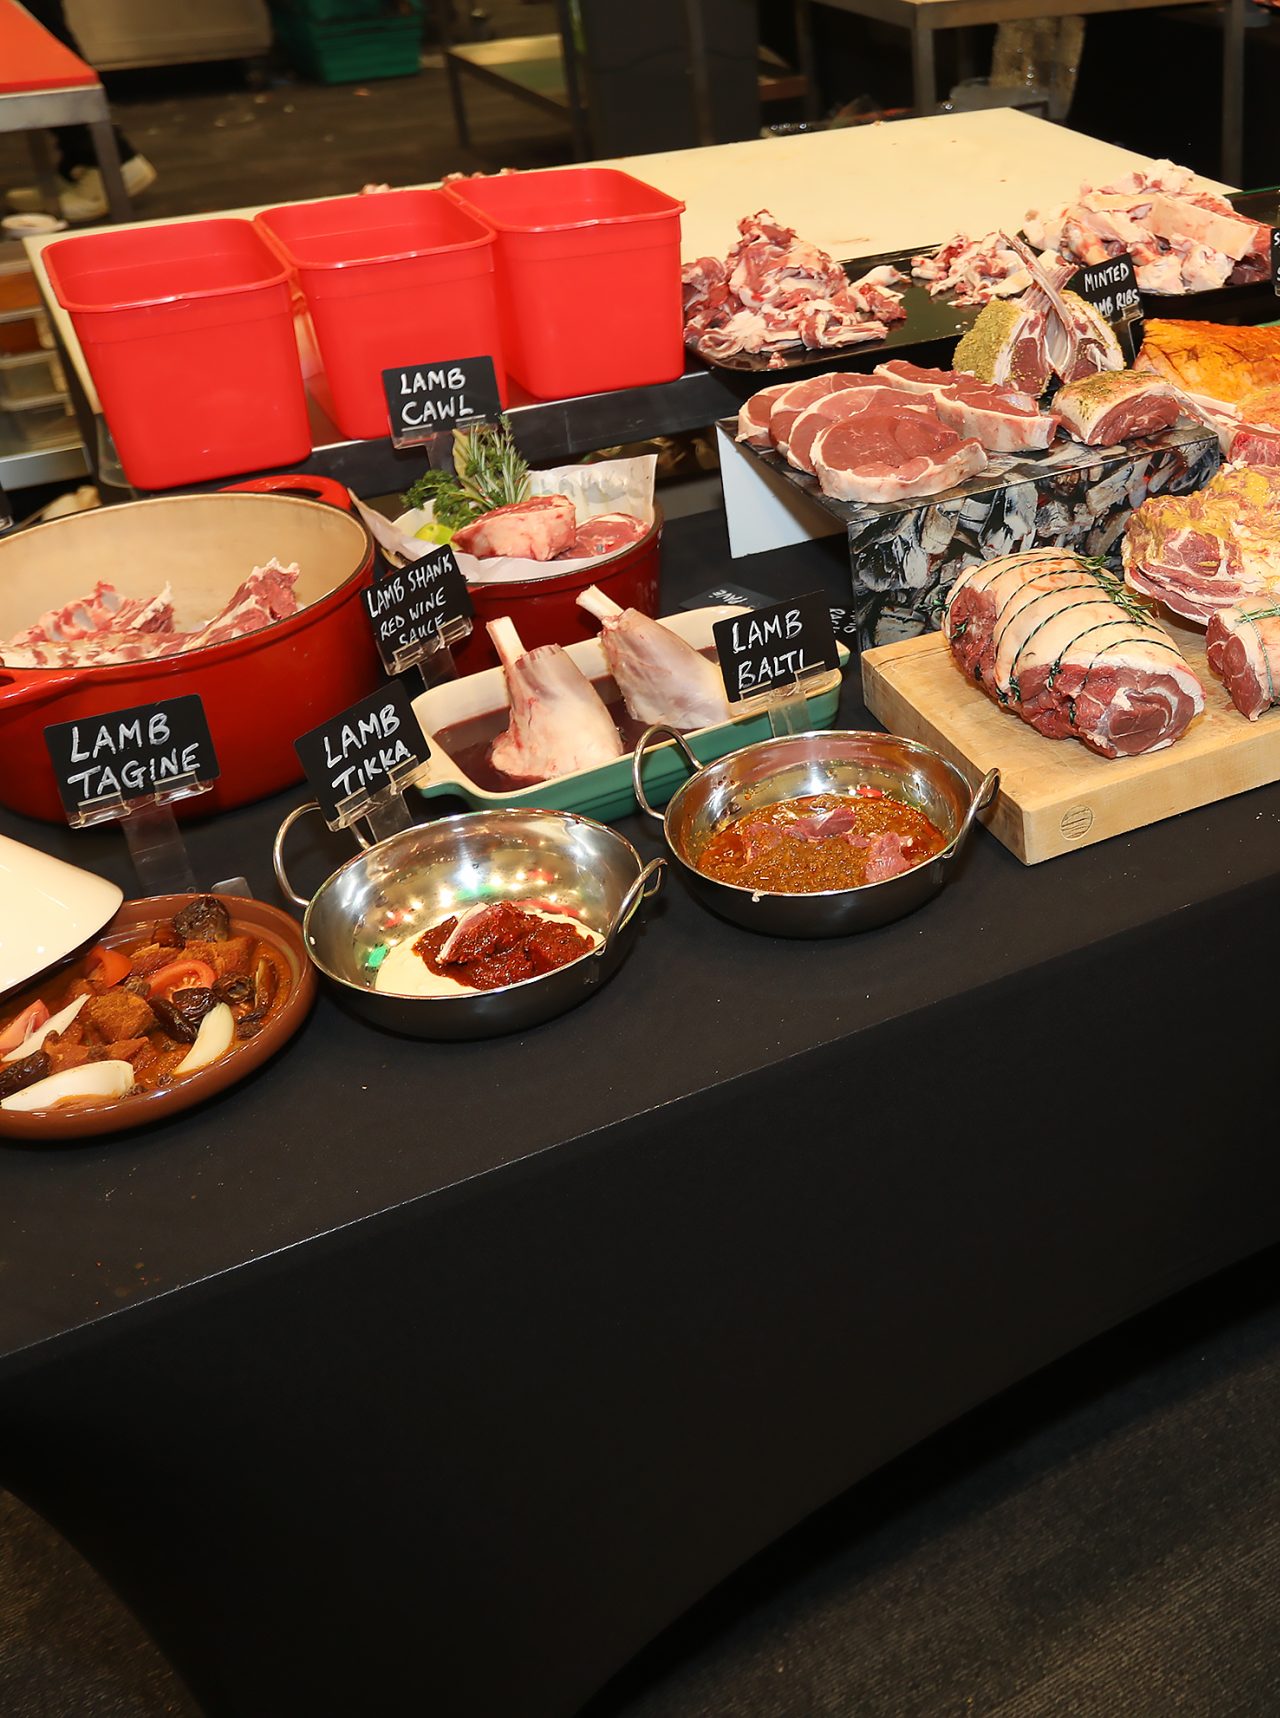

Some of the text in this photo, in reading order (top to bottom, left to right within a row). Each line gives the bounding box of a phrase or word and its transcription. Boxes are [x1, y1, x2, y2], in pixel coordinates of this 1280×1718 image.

[1084, 262, 1130, 293] MINTED
[1093, 288, 1140, 316] MB RIBS
[400, 367, 466, 395] LAMB
[401, 395, 474, 426] CAWL
[367, 553, 453, 618] LAMB SHANK
[379, 586, 447, 641] RED WINE
[399, 612, 446, 645] SAUCE
[732, 609, 803, 654] LAMB
[738, 648, 805, 690] BALTI
[71, 712, 171, 763] LAMB
[324, 703, 401, 769] LAMB
[67, 742, 201, 799] TAGINE
[331, 739, 411, 795] TIKKA
